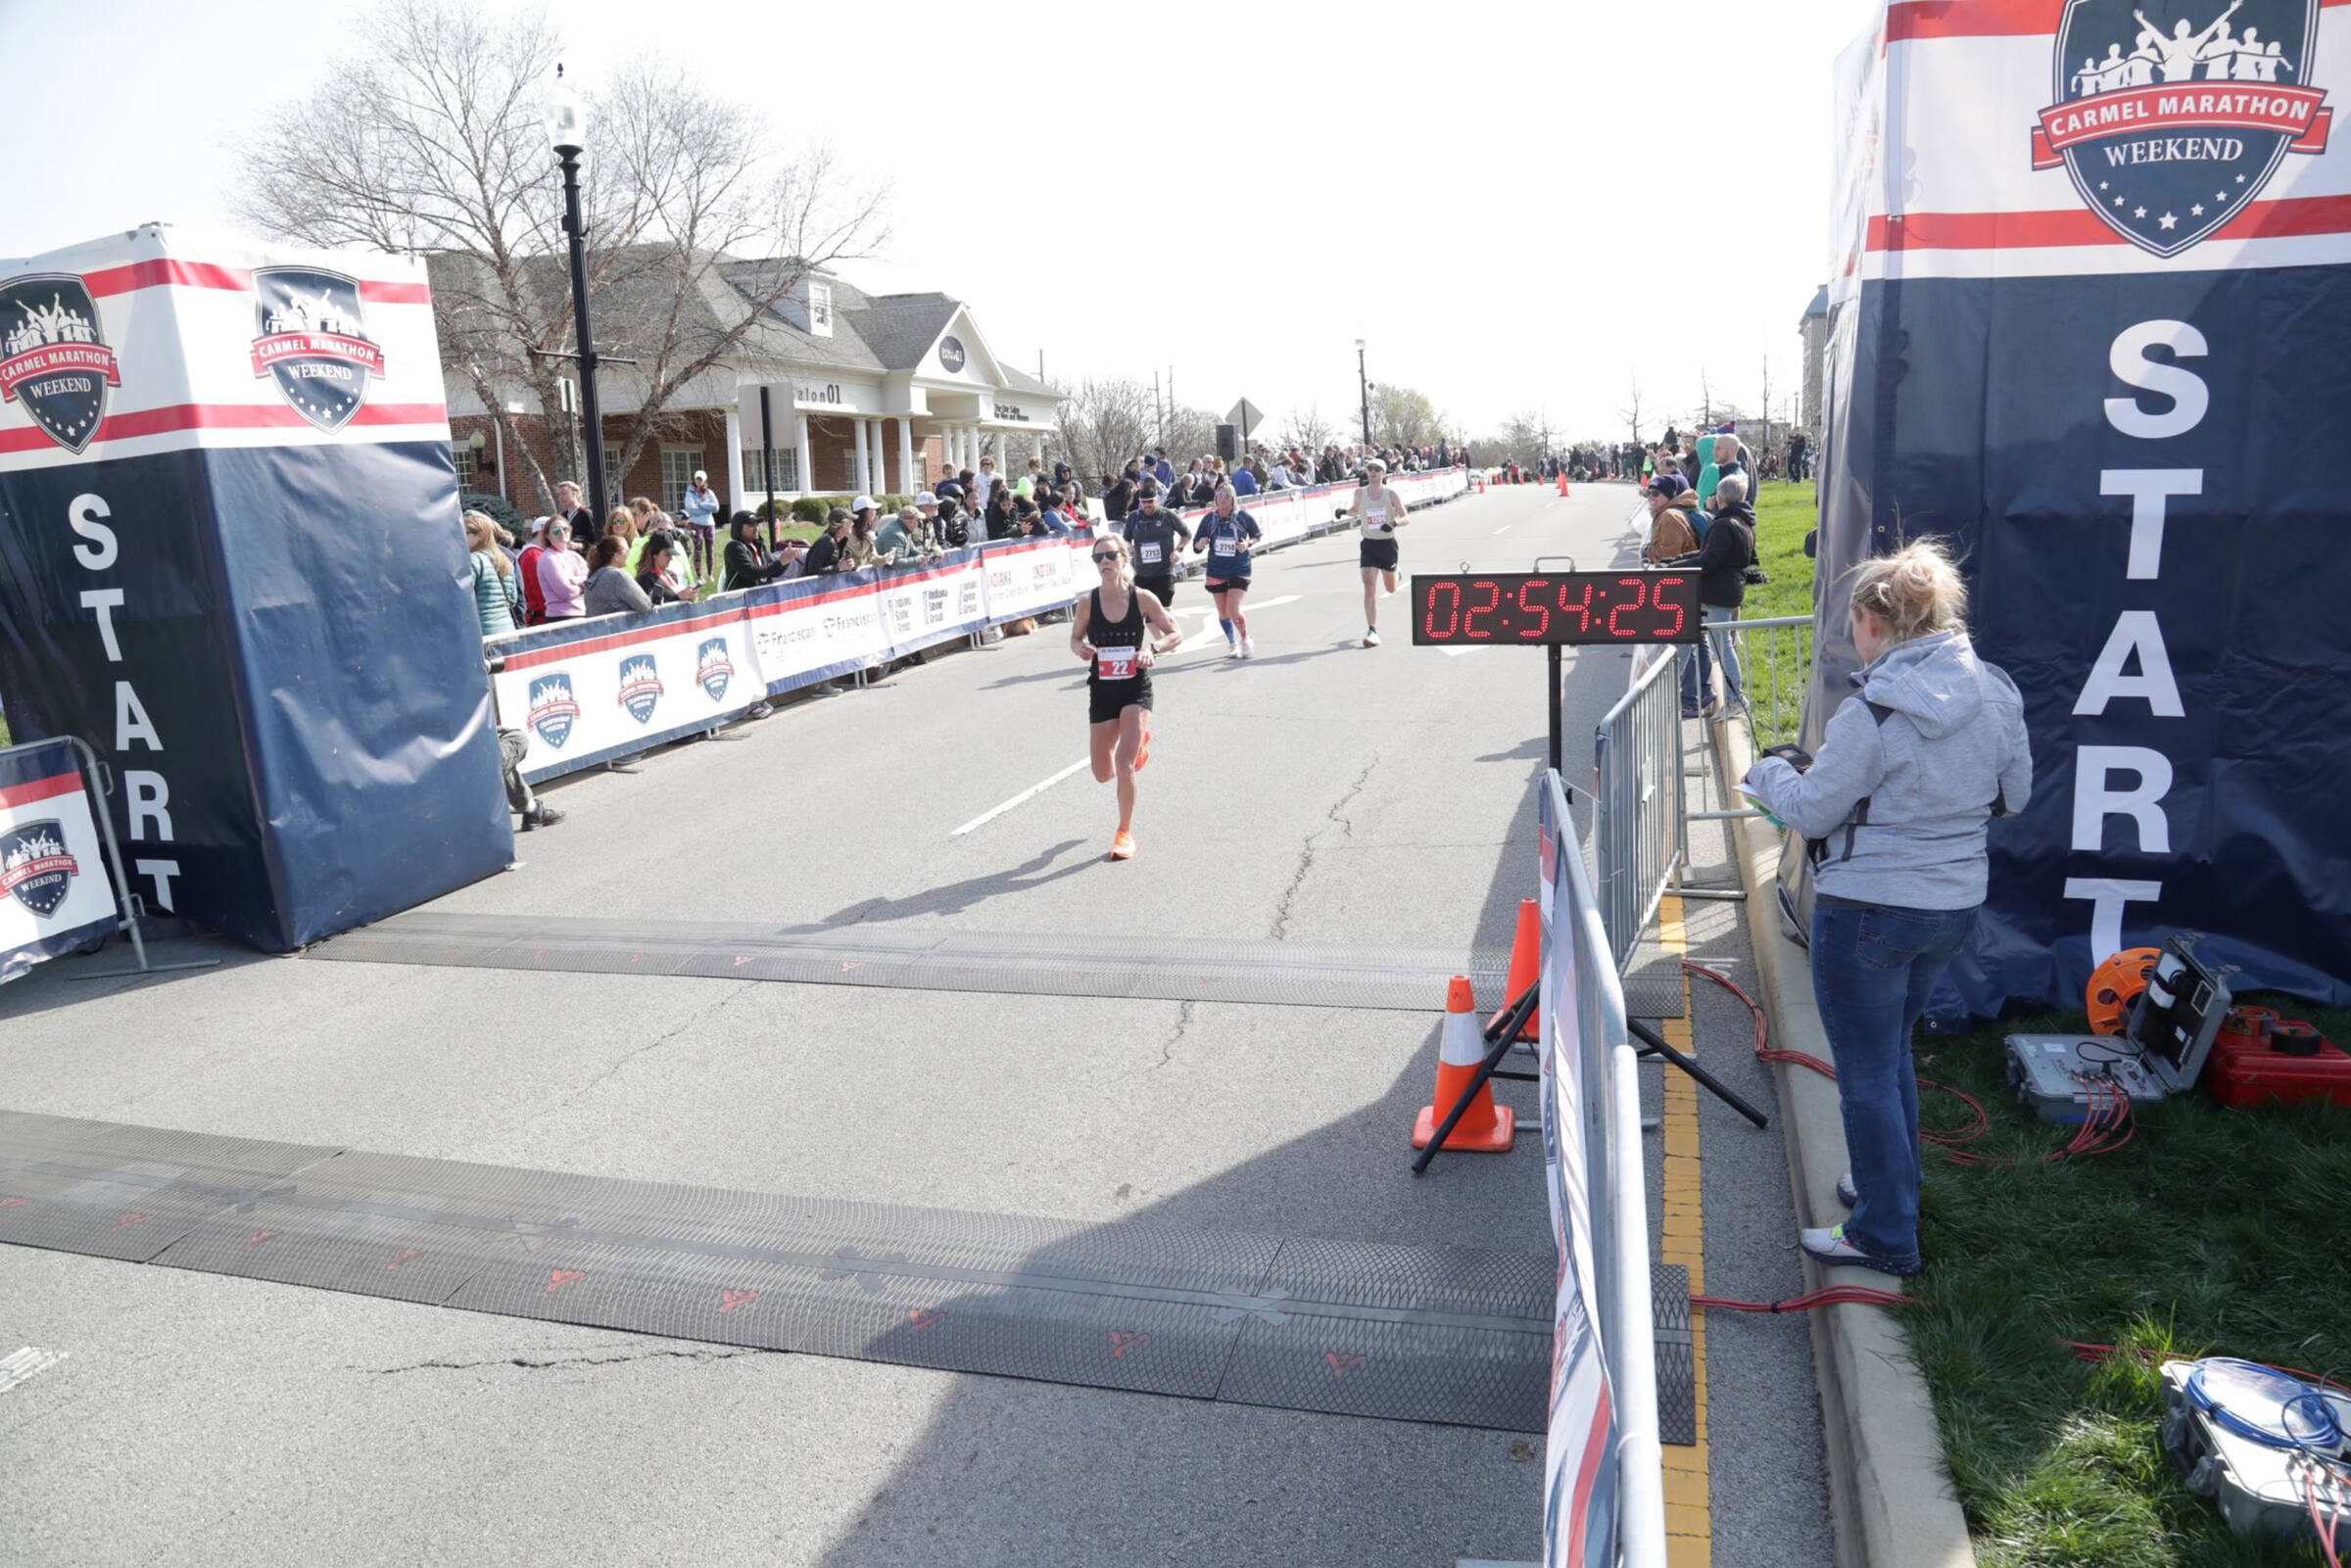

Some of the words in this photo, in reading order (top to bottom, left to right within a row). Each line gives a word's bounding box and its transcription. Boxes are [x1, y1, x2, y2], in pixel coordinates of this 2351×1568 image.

[2050, 100, 2149, 135] CARMEL
[2158, 94, 2310, 120] MARATHON
[2104, 137, 2243, 167] WEEKEND
[259, 339, 307, 357] CARMEL
[310, 338, 375, 360] MARATHON
[1, 356, 47, 381] CARMEL
[48, 350, 109, 366] MARATHON
[287, 363, 352, 380] WEEKEND
[29, 377, 91, 400] WEEKEND
[793, 384, 841, 404] alon01
[1426, 578, 1684, 639] 02:54:25
[771, 627, 816, 648] Franciscan
[2063, 319, 2209, 966] START
[1112, 660, 1128, 676] 22
[69, 493, 180, 914] START
[2, 866, 32, 885] CARMEL
[33, 859, 72, 871] MARATHON
[21, 874, 62, 892] WEEKEND
